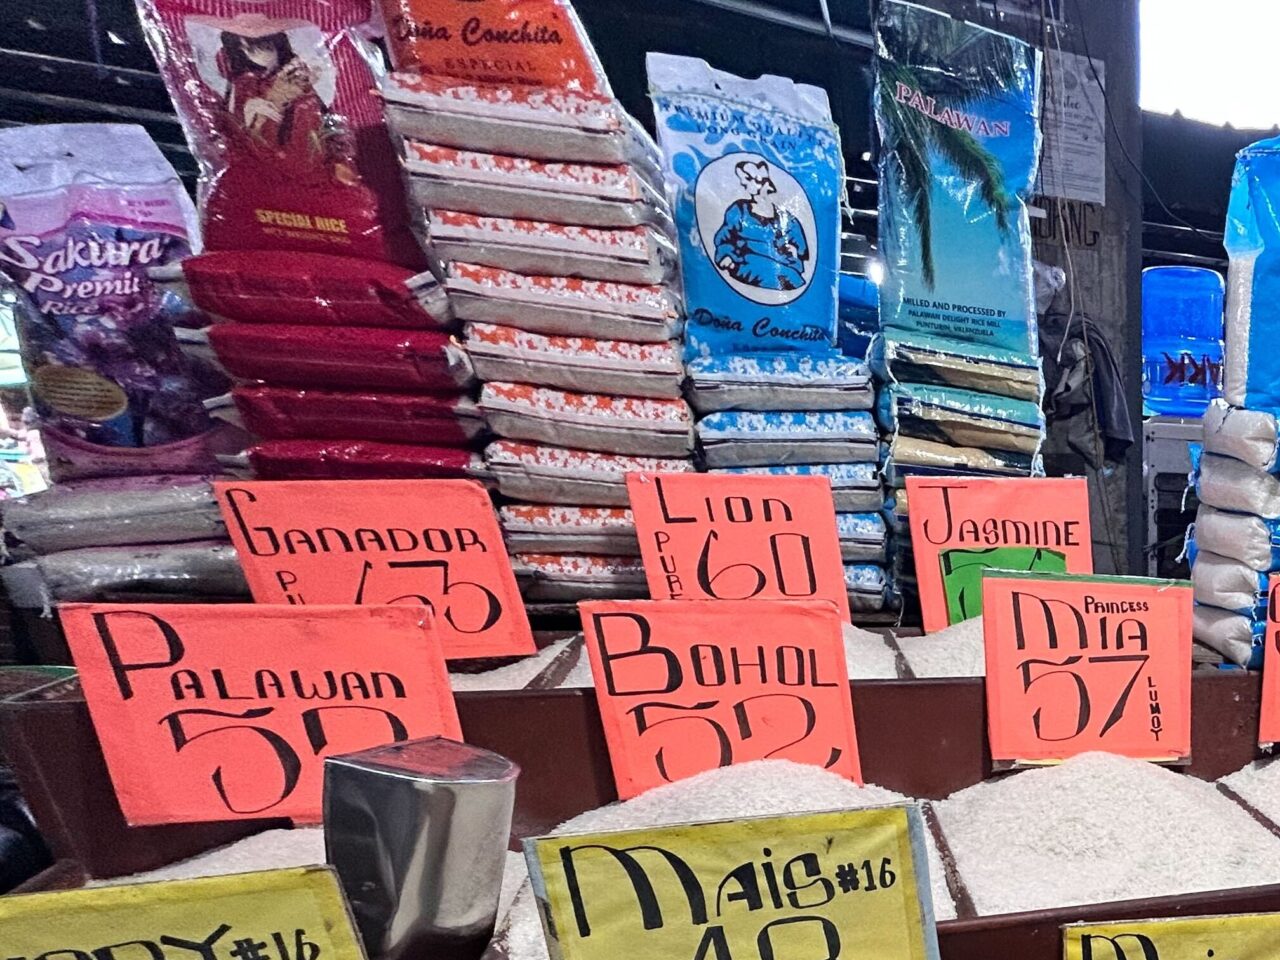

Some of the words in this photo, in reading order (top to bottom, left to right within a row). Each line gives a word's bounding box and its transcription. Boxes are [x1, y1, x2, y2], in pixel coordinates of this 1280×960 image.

[461, 17, 564, 47] Conchita
[662, 101, 745, 124] PREMIUM
[895, 80, 1011, 138] PALAWAN
[255, 208, 313, 230] SPECIAL
[313, 215, 350, 235] RICE
[0, 233, 163, 275] Sakura
[40, 299, 100, 316] Rice
[693, 307, 745, 332] Doña
[752, 316, 826, 342] Conchita
[903, 297, 930, 308] MILLED
[932, 301, 950, 311] AND
[951, 303, 996, 317] PROCESSED
[997, 309, 1007, 318] BY
[908, 309, 941, 321] PALAWAN
[942, 314, 970, 324] DELIGHT
[971, 318, 985, 327] RICE
[987, 320, 1001, 329] MILL
[225, 488, 488, 557] GANADOR
[654, 476, 793, 524] LION
[917, 485, 1080, 546] JASMINE
[697, 529, 817, 600] 60
[1011, 590, 1148, 651] MIA
[1084, 595, 1150, 615] PRINCESS
[92, 609, 408, 701] PALAWAN
[592, 612, 840, 697] BOHOL
[1016, 655, 1150, 742] 57
[625, 693, 843, 783] 52
